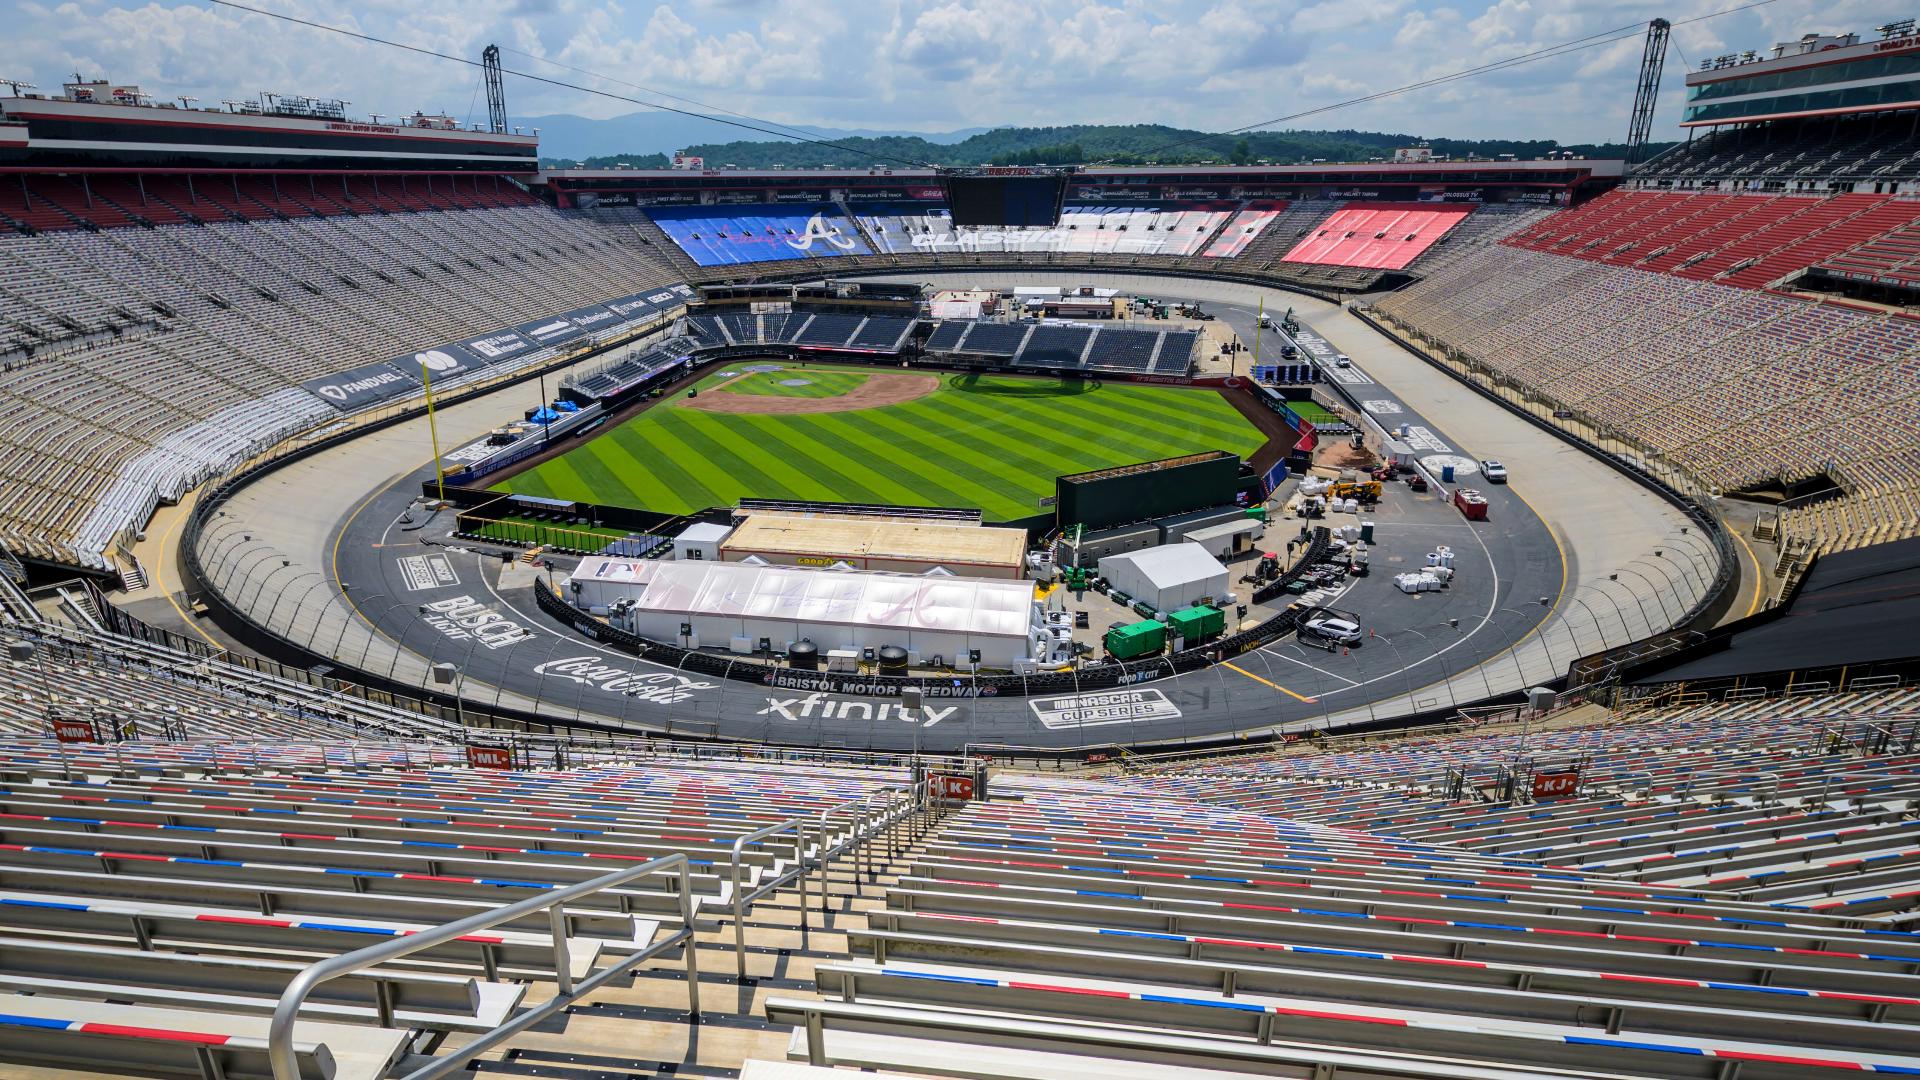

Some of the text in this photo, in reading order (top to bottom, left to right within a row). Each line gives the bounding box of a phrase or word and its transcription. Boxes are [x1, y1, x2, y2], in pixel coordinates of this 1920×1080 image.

[342, 372, 400, 394] FANDUEL
[424, 595, 537, 650] BUSCH
[424, 614, 474, 640] LIGHT
[777, 676, 838, 693] BRISTOL
[841, 682, 896, 695] MOTOR
[1118, 673, 1137, 684] FOOD
[1145, 670, 1159, 680] CITY
[1077, 692, 1144, 708] NASCAR
[756, 692, 958, 728] xfinity
[1061, 704, 1155, 721] CUP SERIES
[62, 727, 86, 738] NM
[477, 753, 502, 764] ML
